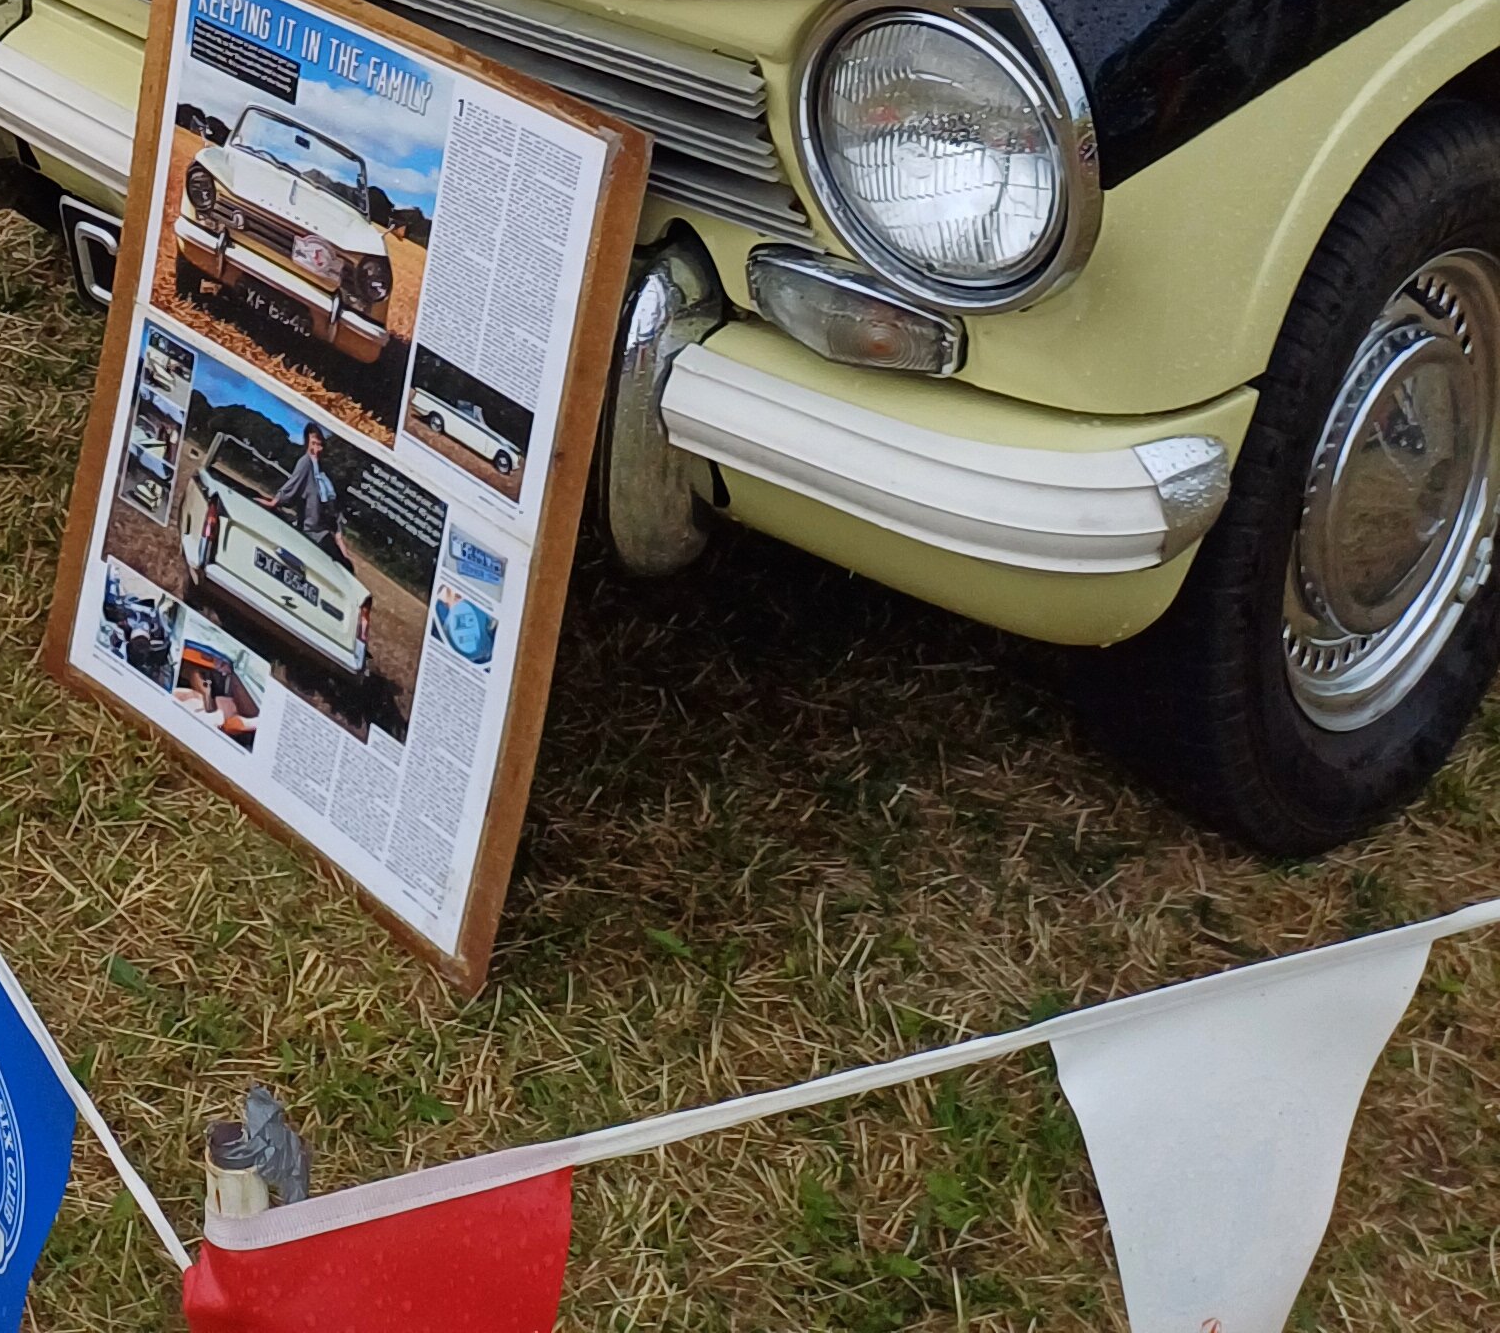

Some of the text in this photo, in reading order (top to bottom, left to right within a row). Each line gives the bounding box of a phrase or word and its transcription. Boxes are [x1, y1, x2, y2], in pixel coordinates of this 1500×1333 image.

[276, 14, 297, 52] IT
[301, 25, 321, 65] IN
[328, 36, 364, 83] THE
[366, 56, 434, 116] FAMILY
[3, 1156, 18, 1226] CLUB
